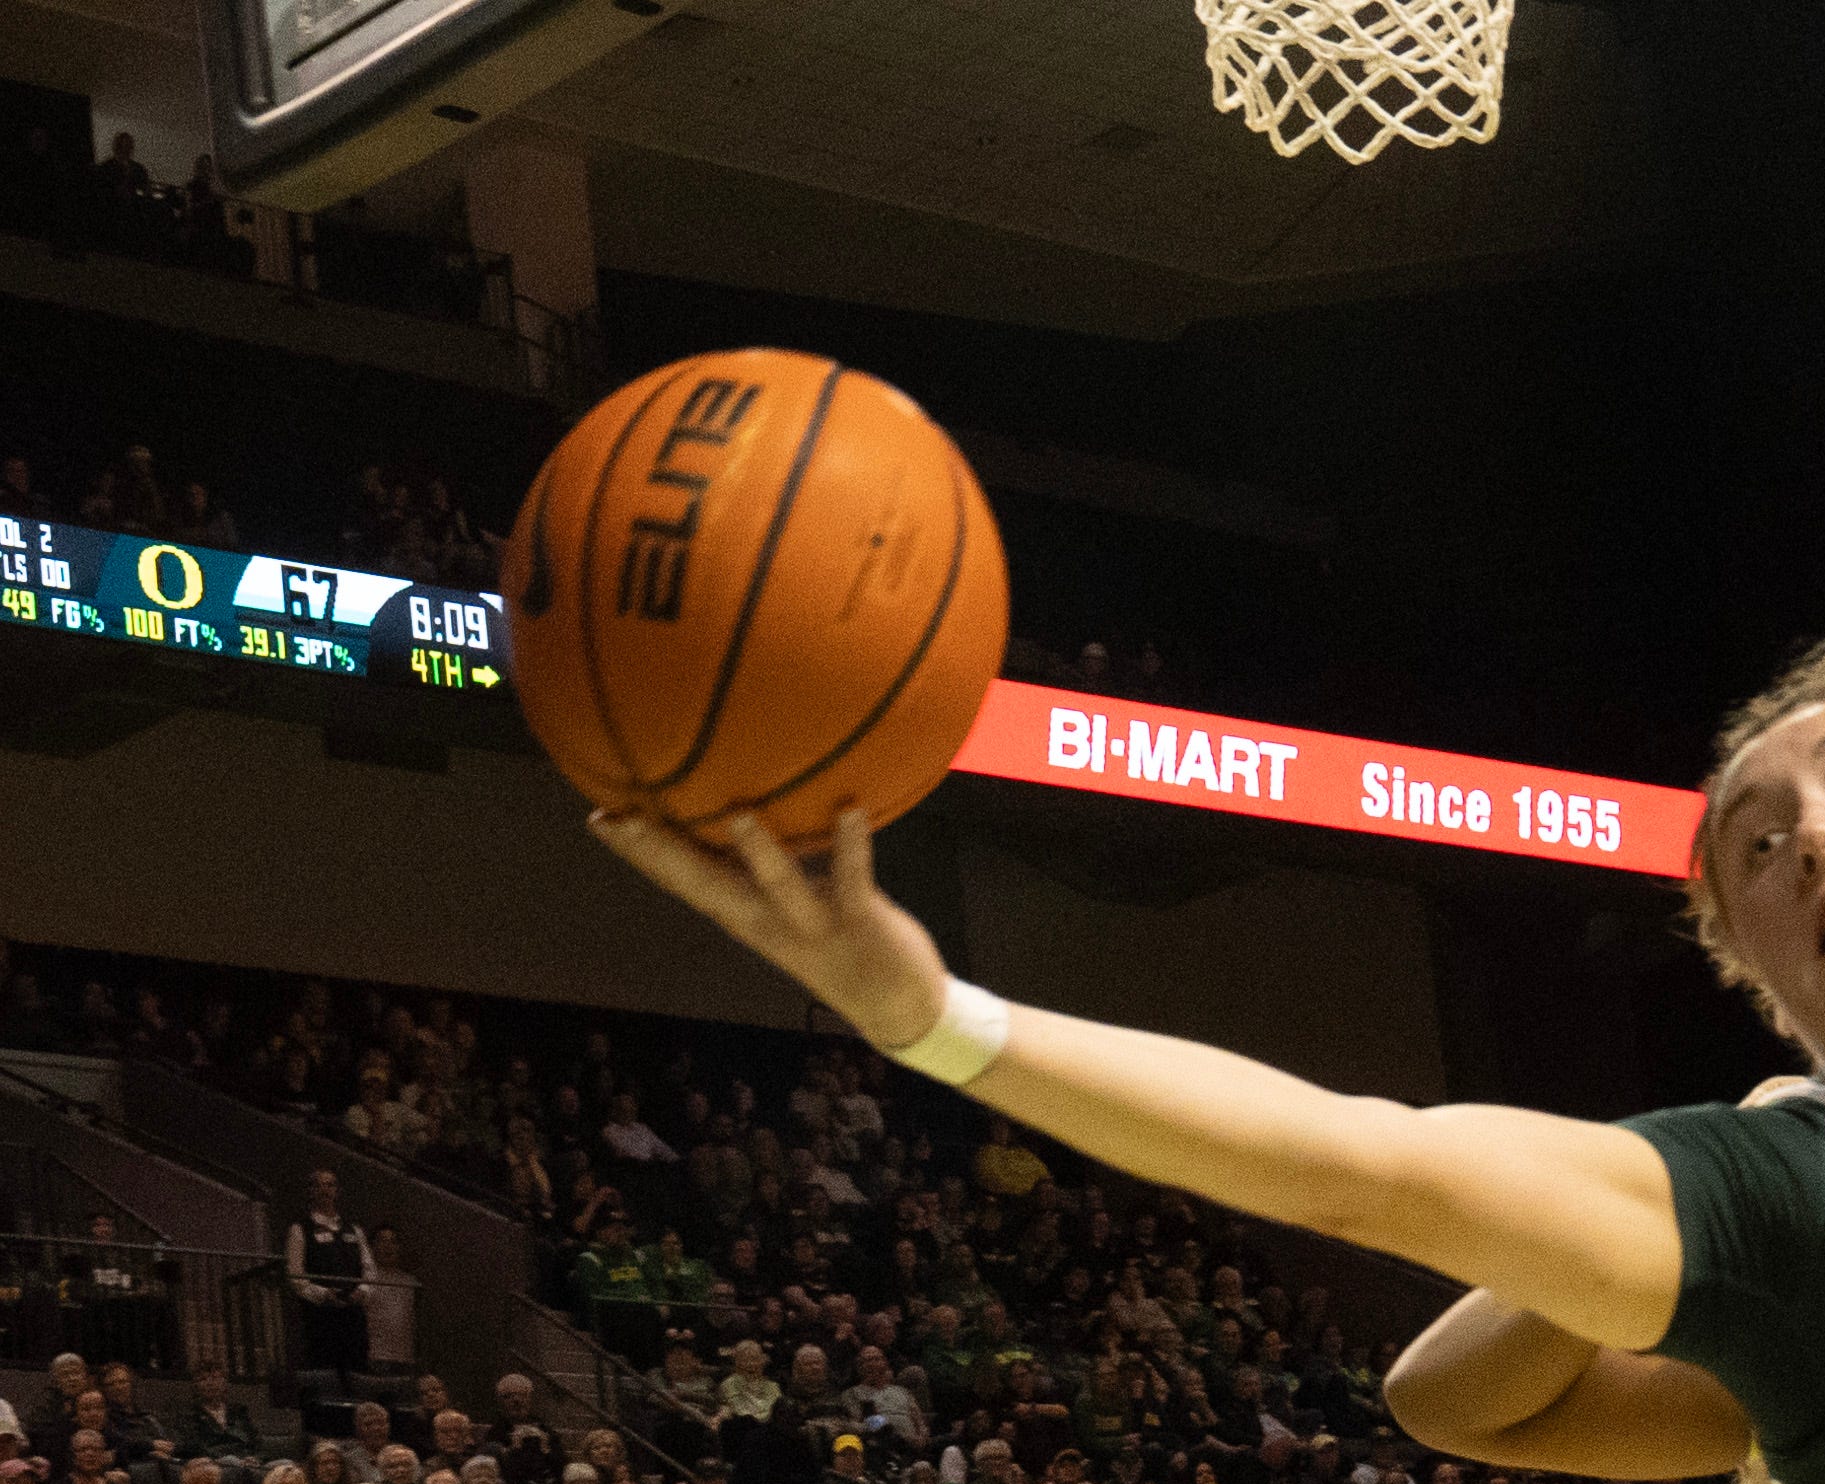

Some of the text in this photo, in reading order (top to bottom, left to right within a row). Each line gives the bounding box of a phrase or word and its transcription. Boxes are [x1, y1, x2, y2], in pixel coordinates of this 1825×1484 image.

[39, 523, 53, 553] 2
[0, 551, 71, 590] LS 00
[2, 588, 105, 633] 49 FG%
[123, 606, 223, 652] 100 FT%
[409, 596, 489, 650] 8:09
[239, 625, 356, 672] 39.1 3PT%
[411, 648, 463, 689] 4TH
[1361, 761, 1492, 833] Since
[1512, 785, 1621, 853] 1955
